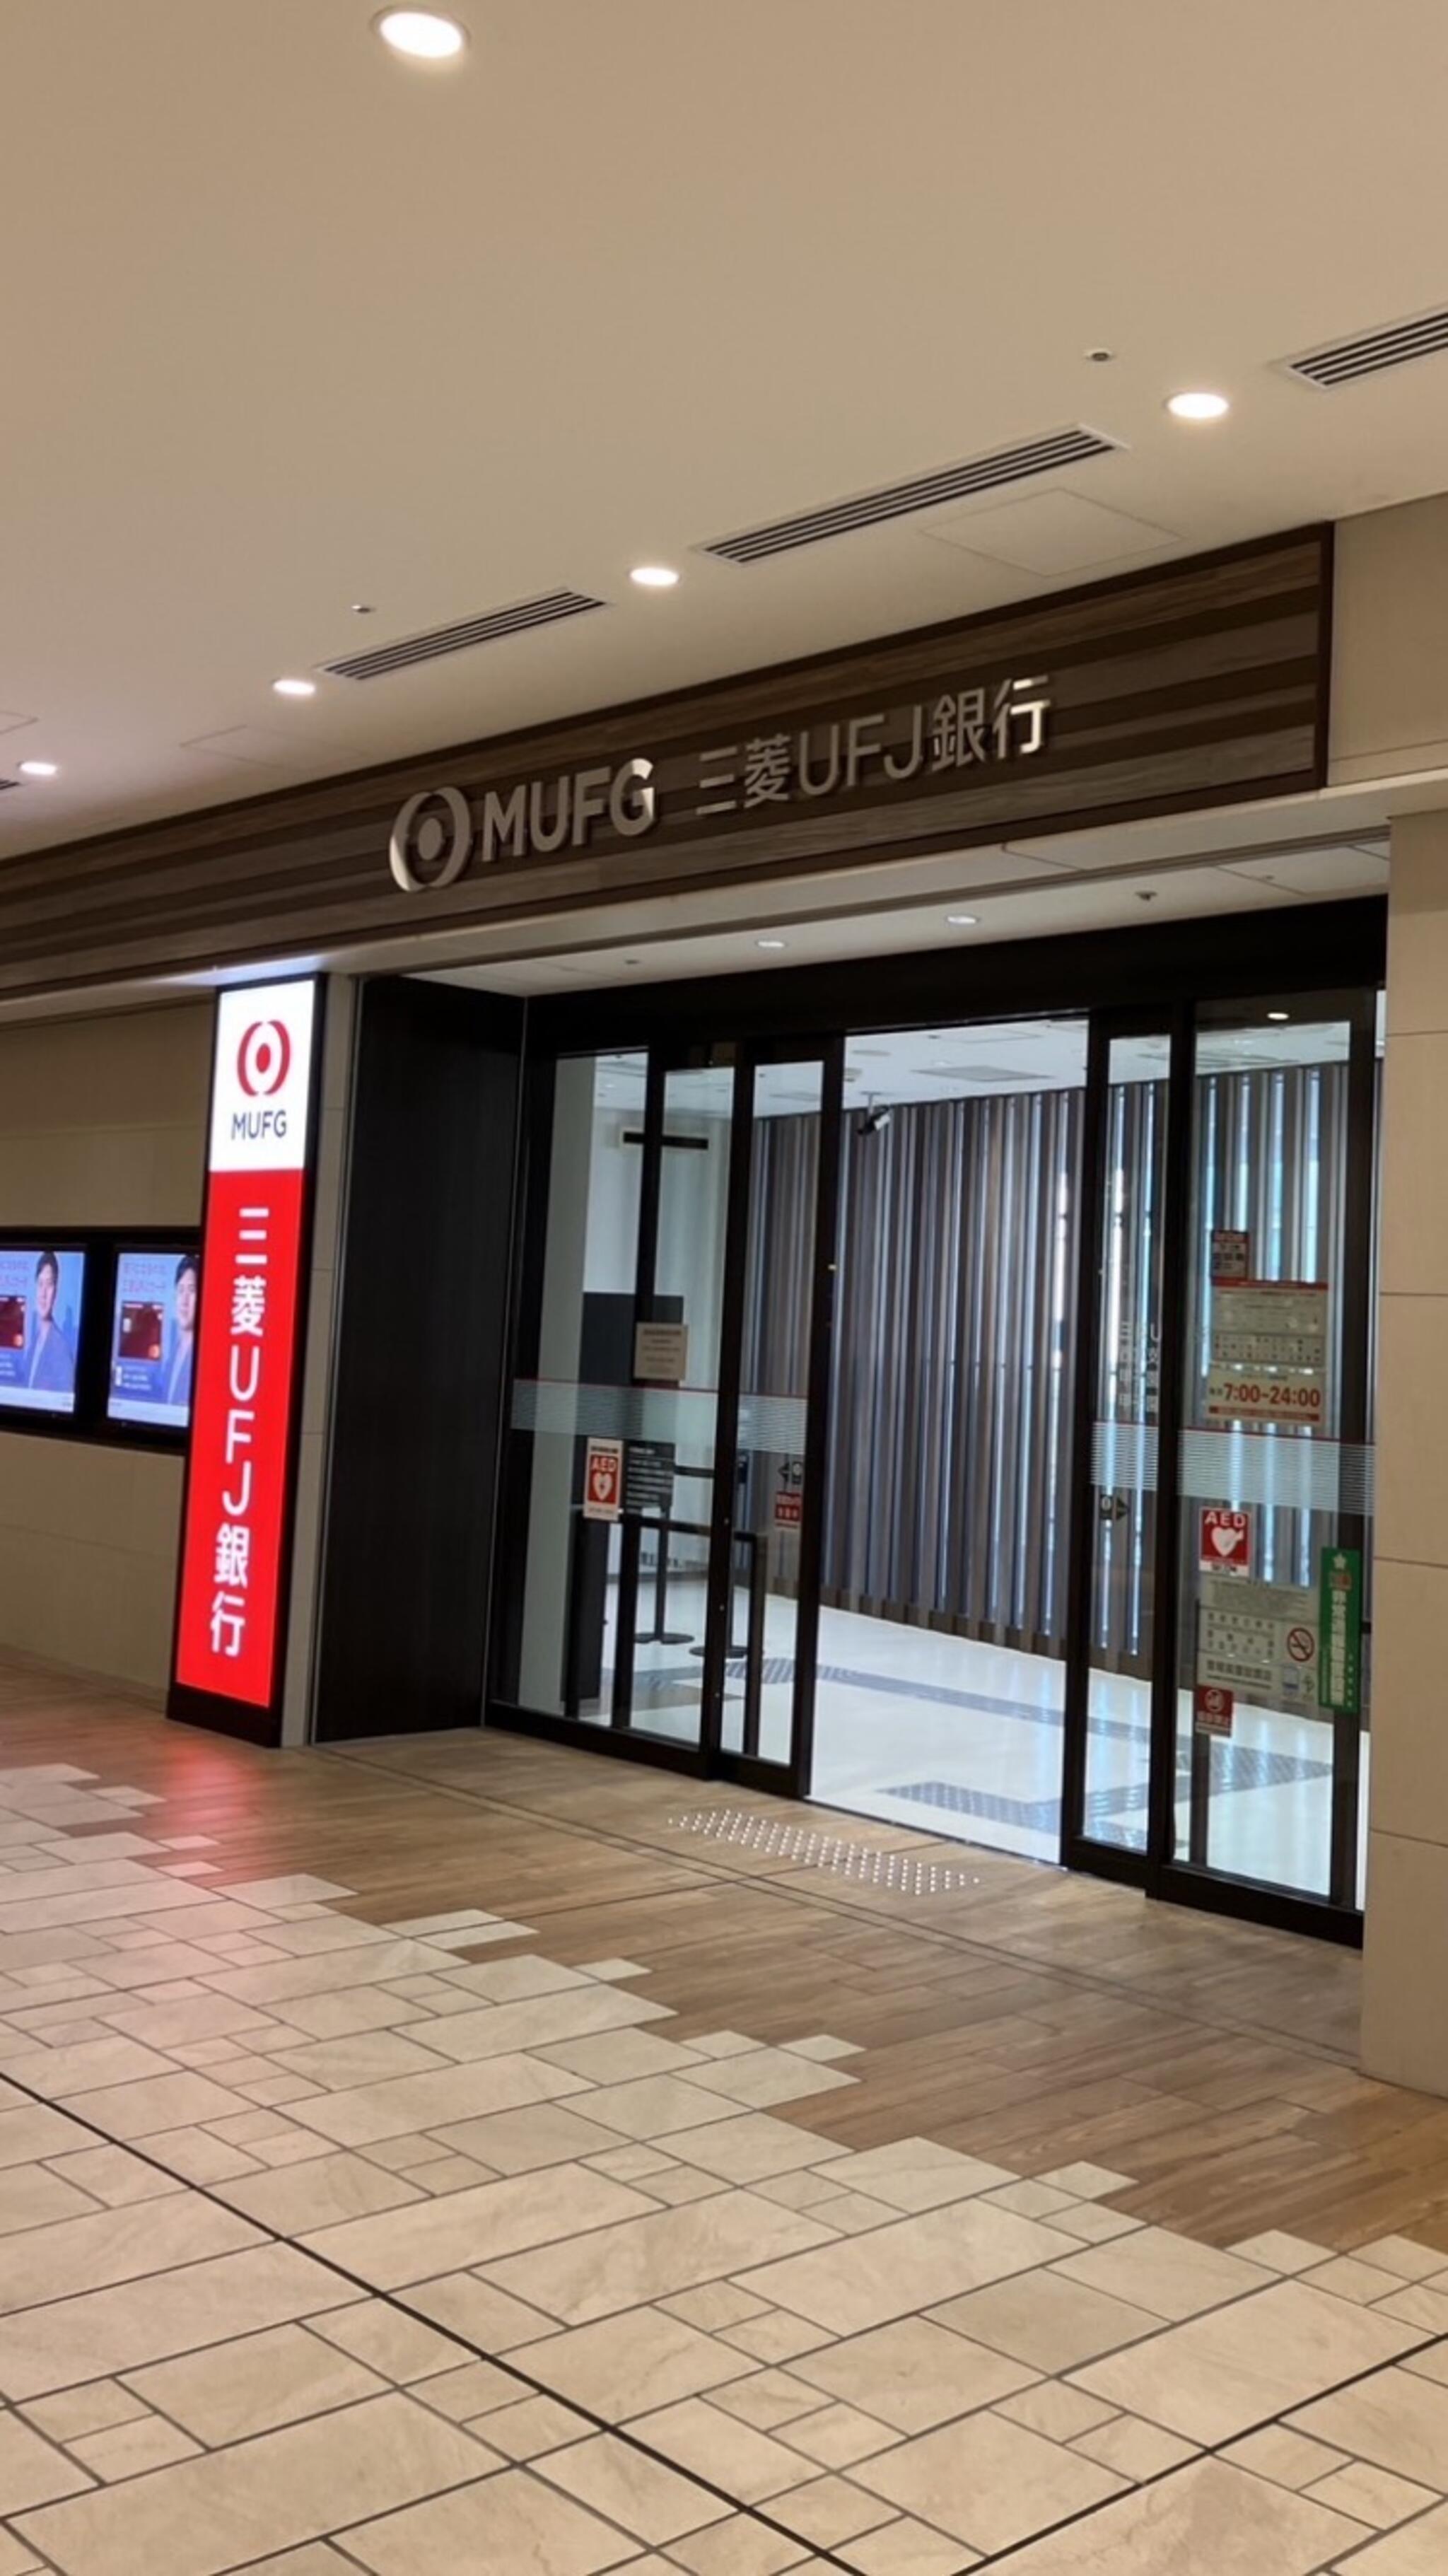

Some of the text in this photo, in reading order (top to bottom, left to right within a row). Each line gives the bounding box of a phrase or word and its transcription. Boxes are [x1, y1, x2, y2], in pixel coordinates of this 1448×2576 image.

[481, 675, 1051, 863] MUFG 三菱UFJ銀行
[231, 1110, 286, 1141] MUFG
[210, 1206, 269, 1658] 三菱UFJ銀行
[591, 1457, 617, 1472] AED
[1204, 1510, 1246, 1528] AED
